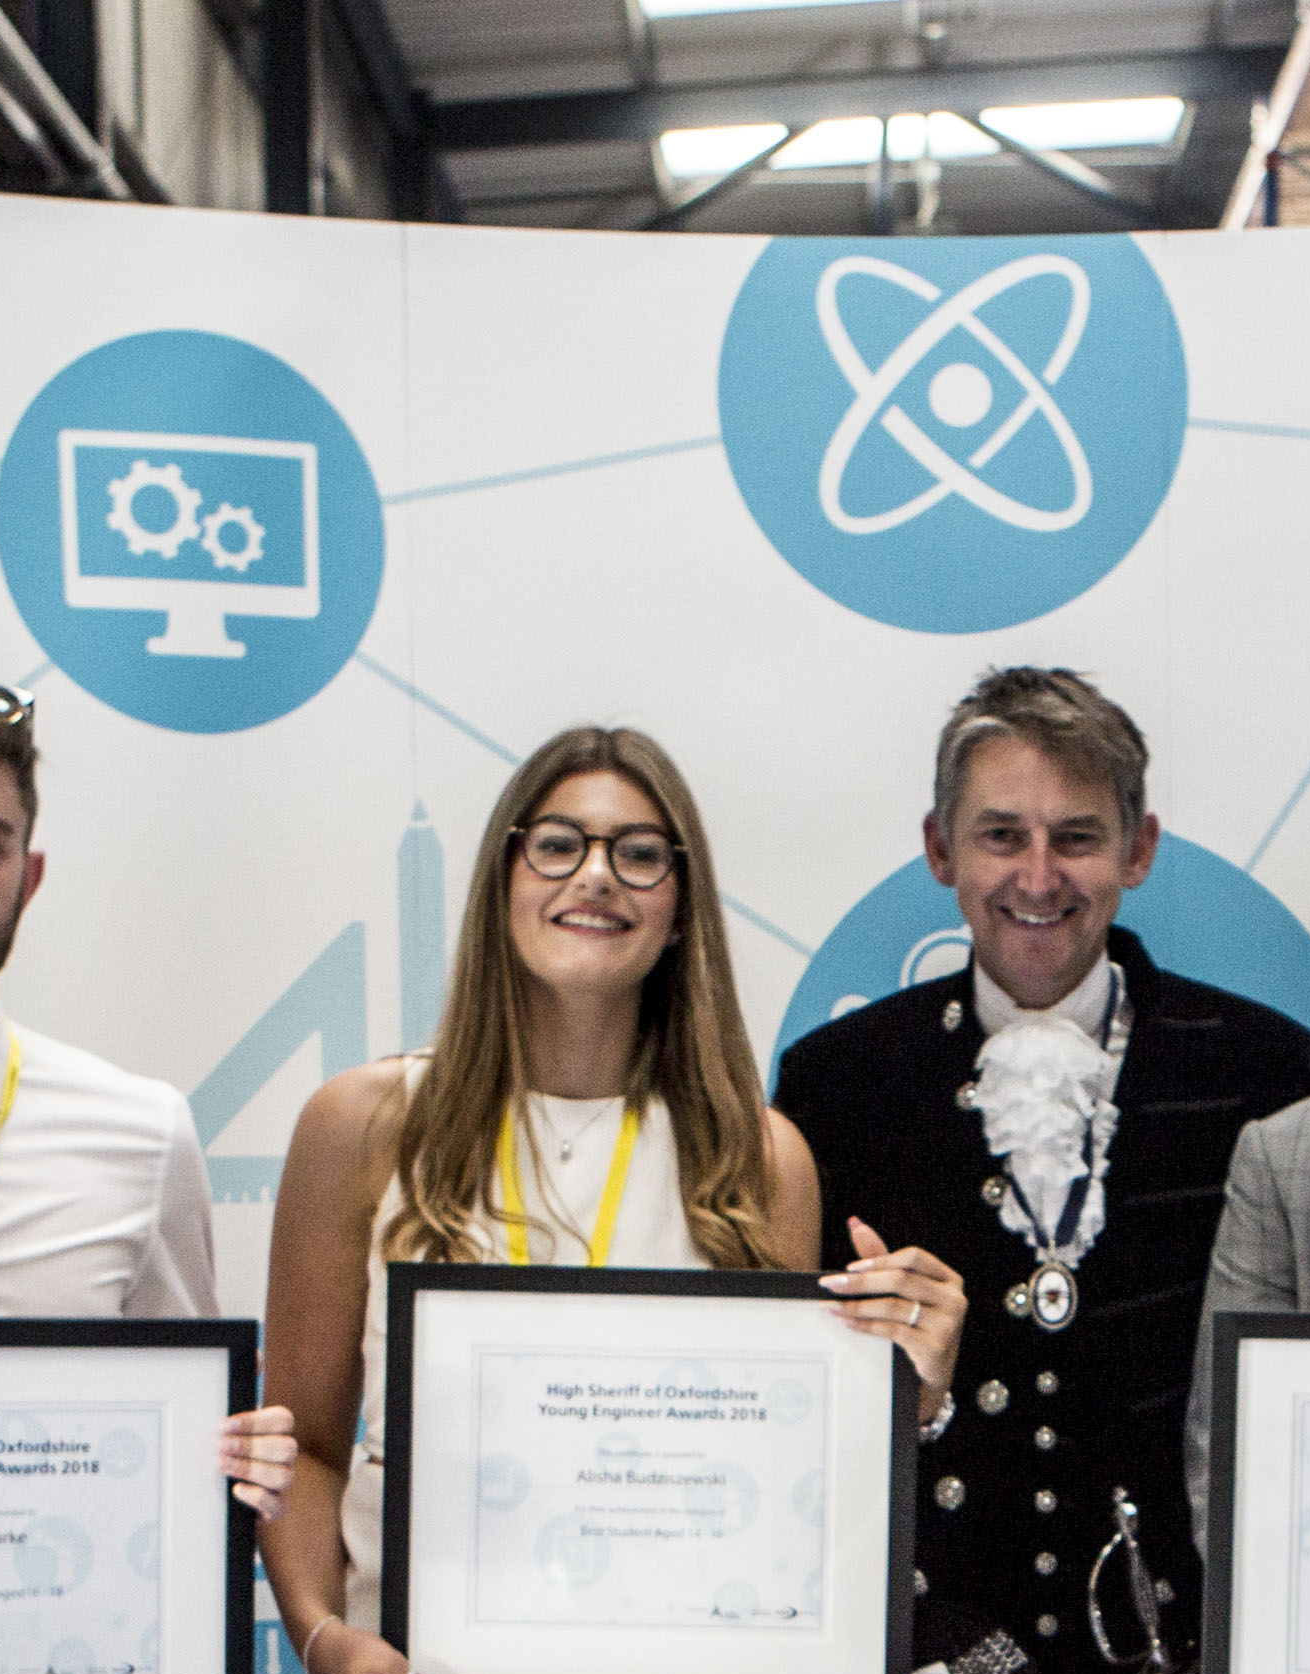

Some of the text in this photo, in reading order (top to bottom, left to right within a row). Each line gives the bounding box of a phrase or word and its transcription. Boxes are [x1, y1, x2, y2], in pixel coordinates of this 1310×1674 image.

[547, 1384, 759, 1400] High Sheriff of Oxfordshire
[539, 1404, 767, 1421] Young Engineer Awards 2018
[61, 1461, 100, 1474] 2018
[577, 1470, 622, 1483] Alisha
